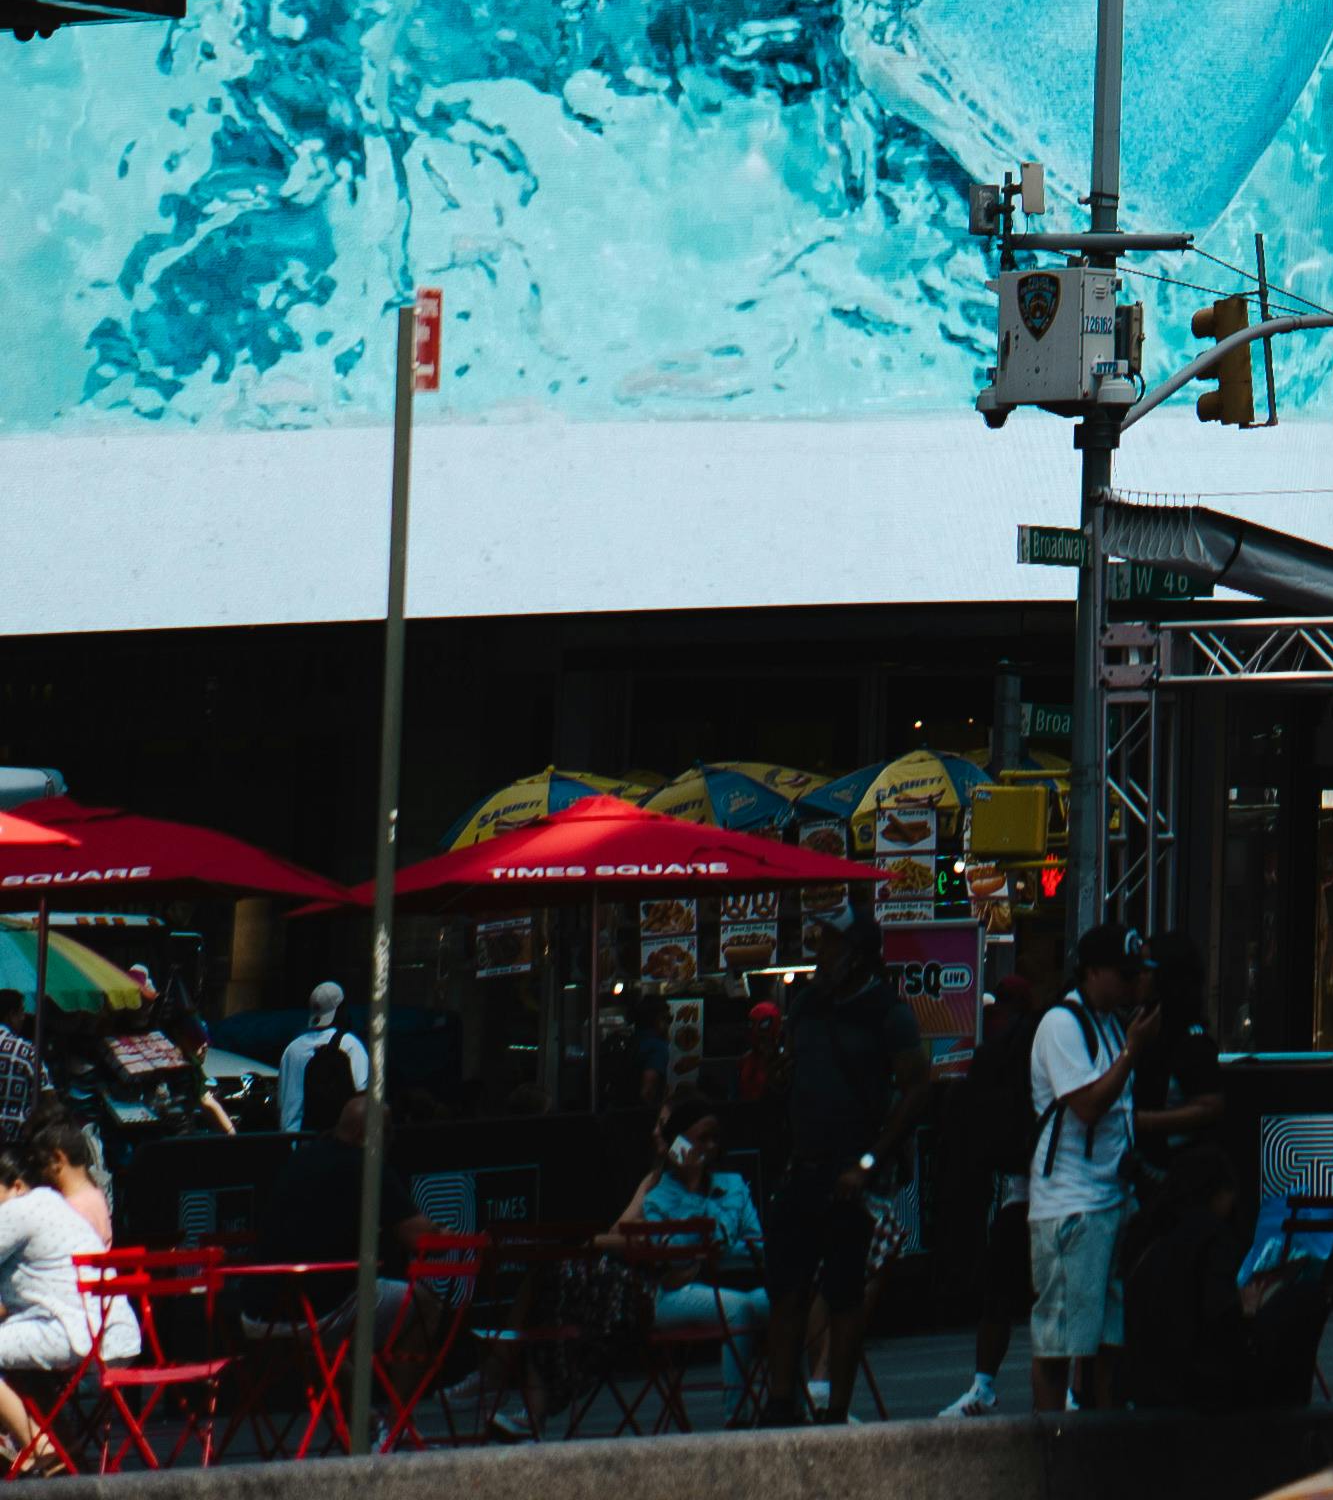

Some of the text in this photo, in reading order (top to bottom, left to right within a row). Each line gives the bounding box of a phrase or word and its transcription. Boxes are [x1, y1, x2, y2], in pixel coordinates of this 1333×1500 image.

[1033, 530, 1087, 566] Broadway
[1135, 566, 1153, 594] W
[1, 865, 152, 887] SQUARE
[488, 861, 729, 879] TIMES SQUARE
